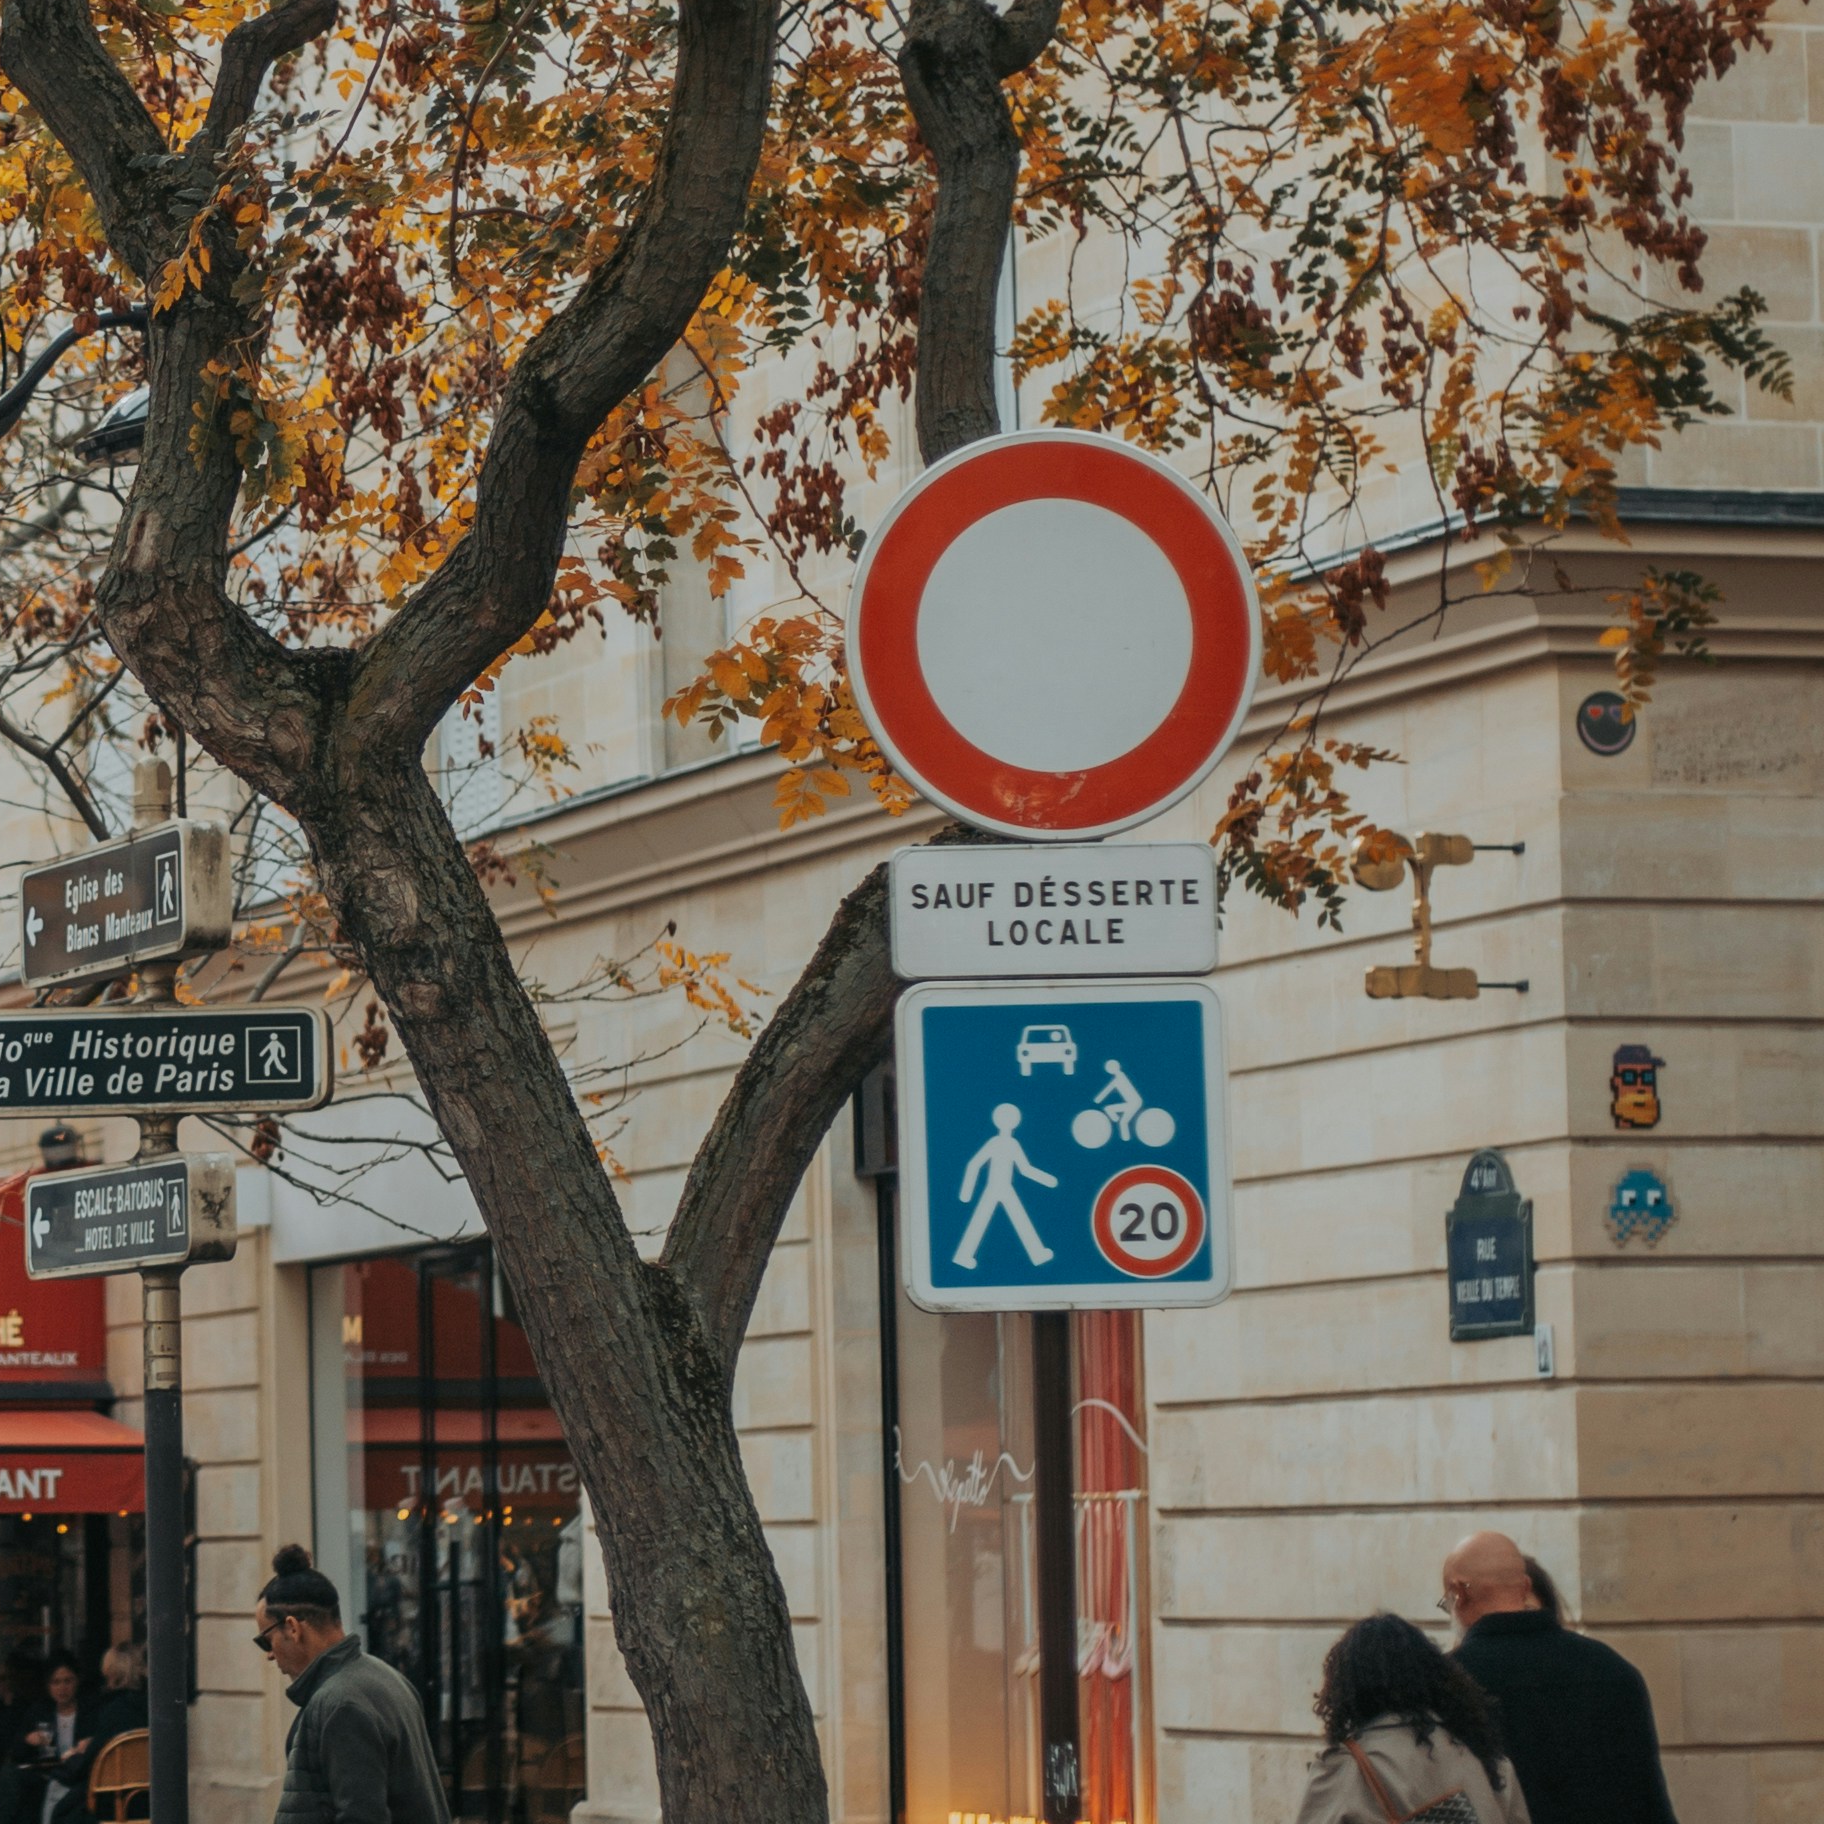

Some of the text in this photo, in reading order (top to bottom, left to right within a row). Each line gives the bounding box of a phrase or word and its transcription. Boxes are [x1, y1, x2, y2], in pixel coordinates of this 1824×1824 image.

[65, 868, 124, 914] Eglise des
[911, 876, 1199, 909] SAUF DÉSSERTE
[66, 908, 154, 953] Blancs Manteaux
[988, 918, 1125, 946] LOCALE
[69, 1028, 236, 1064] Historique
[26, 1066, 95, 1098] Ville
[106, 1065, 144, 1095] de
[154, 1062, 236, 1094] Paris
[74, 1177, 165, 1219] ESCALE-BATOBUS
[115, 1223, 128, 1248] DE
[130, 1219, 155, 1245] VILLE
[1119, 1202, 1179, 1242] 20
[1477, 1237, 1497, 1262] RUE
